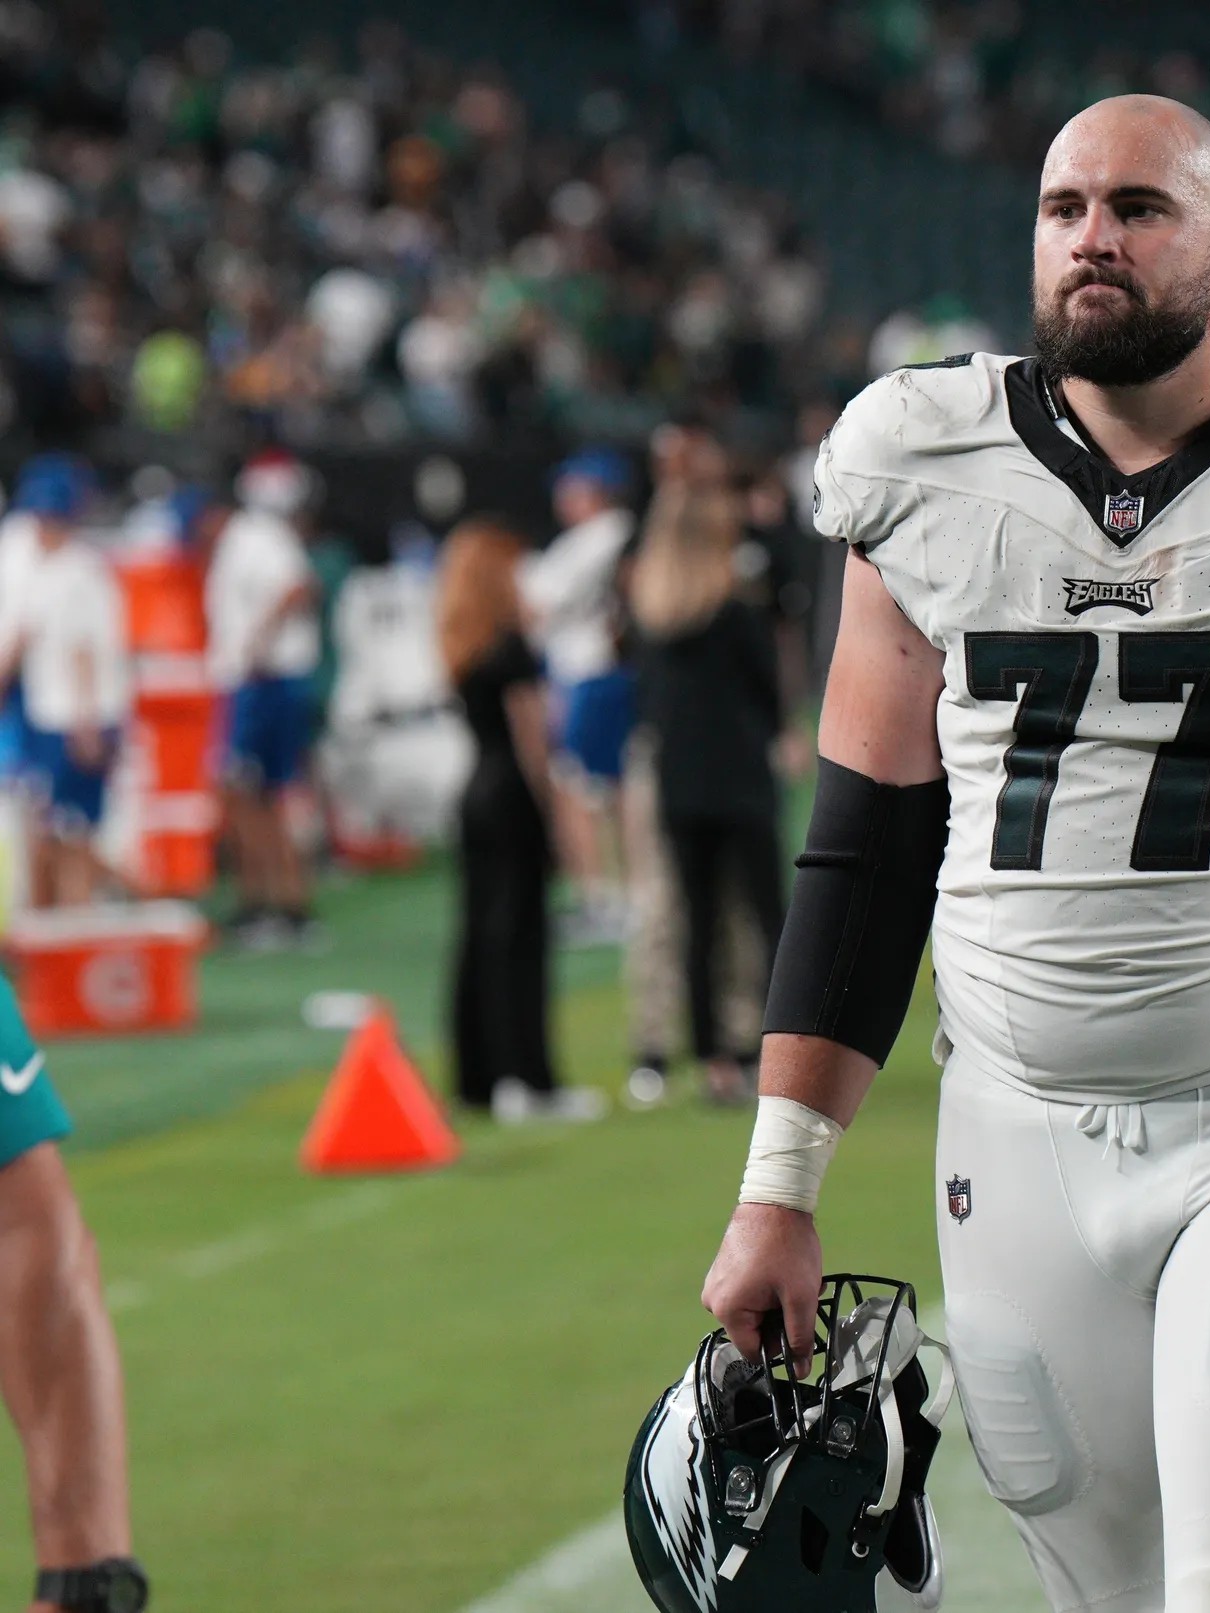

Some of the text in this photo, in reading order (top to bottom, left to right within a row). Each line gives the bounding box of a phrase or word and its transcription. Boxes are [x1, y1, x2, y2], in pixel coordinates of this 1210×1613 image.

[1110, 510, 1136, 528] NFL
[1064, 578, 1159, 611] EAGLES
[949, 1195, 968, 1214] NFL
